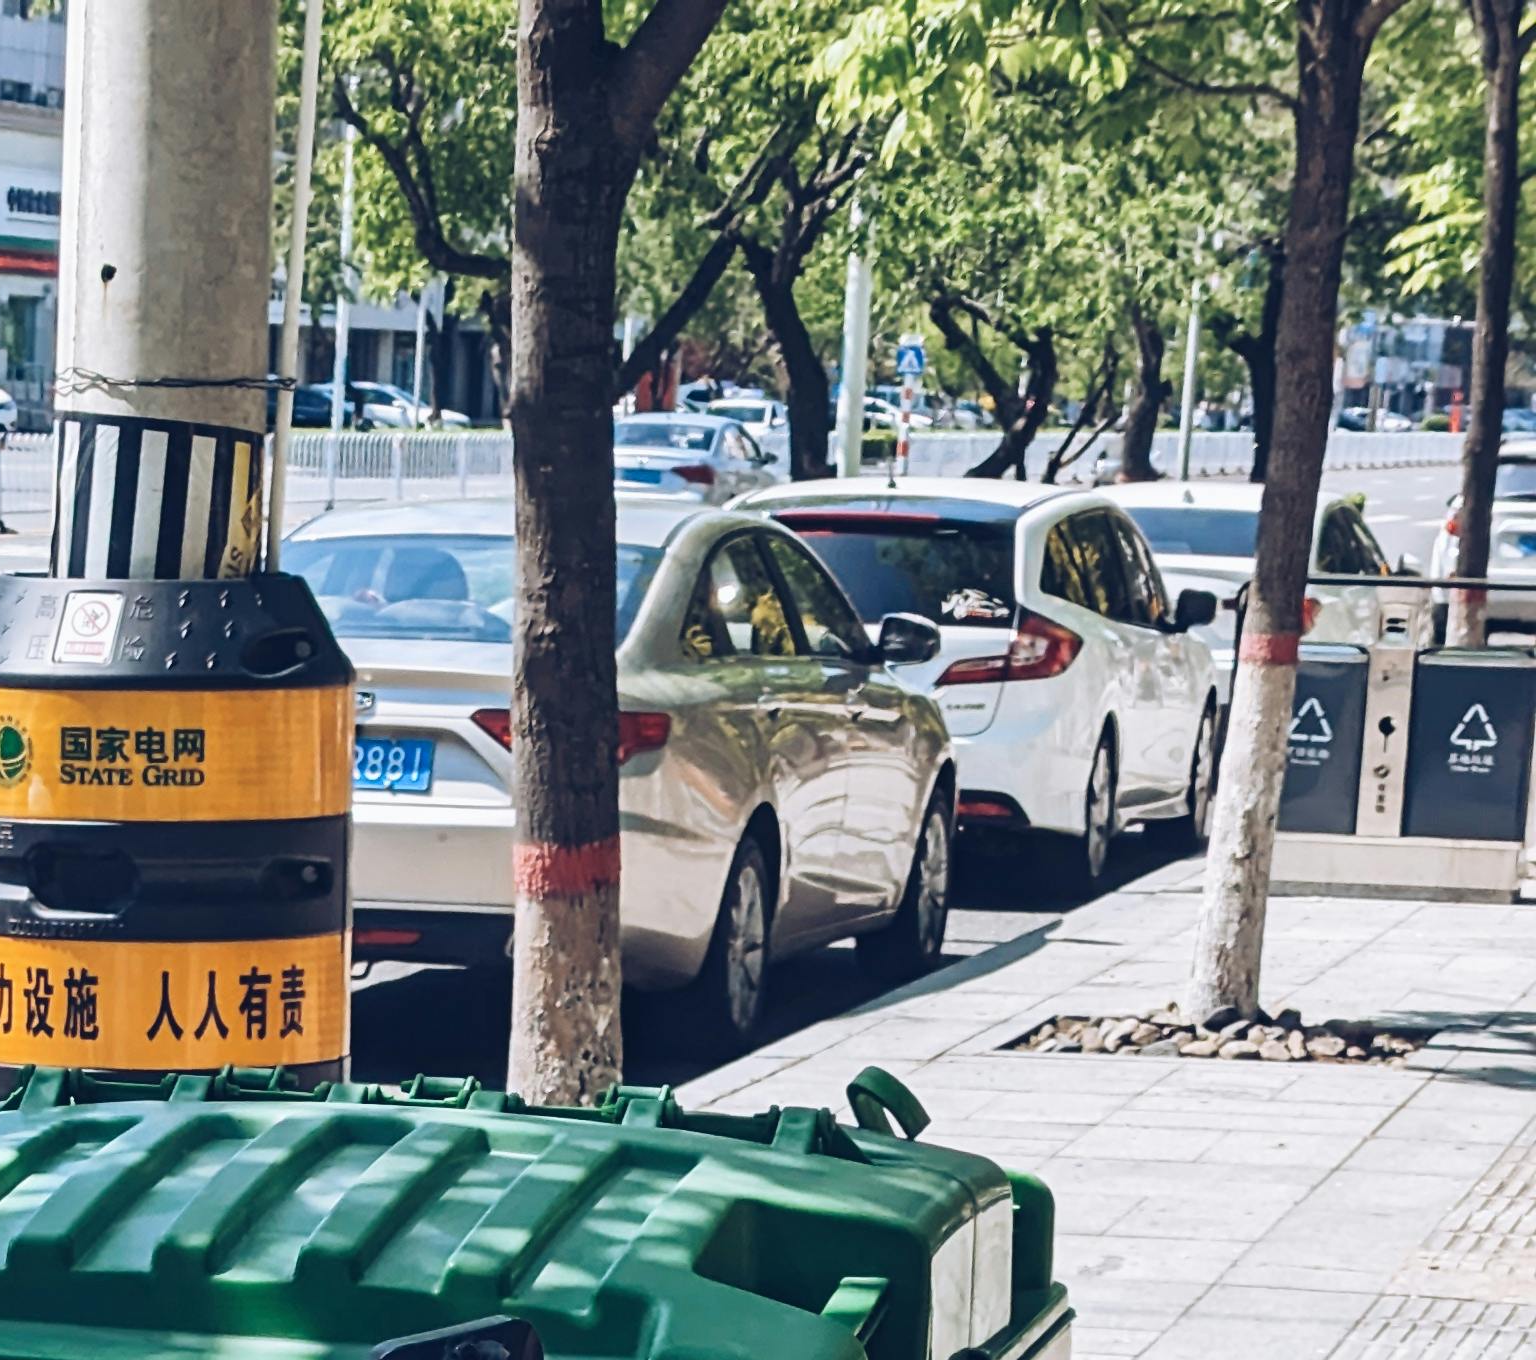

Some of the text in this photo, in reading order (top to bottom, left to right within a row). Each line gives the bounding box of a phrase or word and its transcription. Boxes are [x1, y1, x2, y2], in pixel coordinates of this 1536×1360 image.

[60, 726, 205, 764] 国家电网
[60, 764, 205, 786] STATE GRID
[147, 964, 306, 1041] 人人有责
